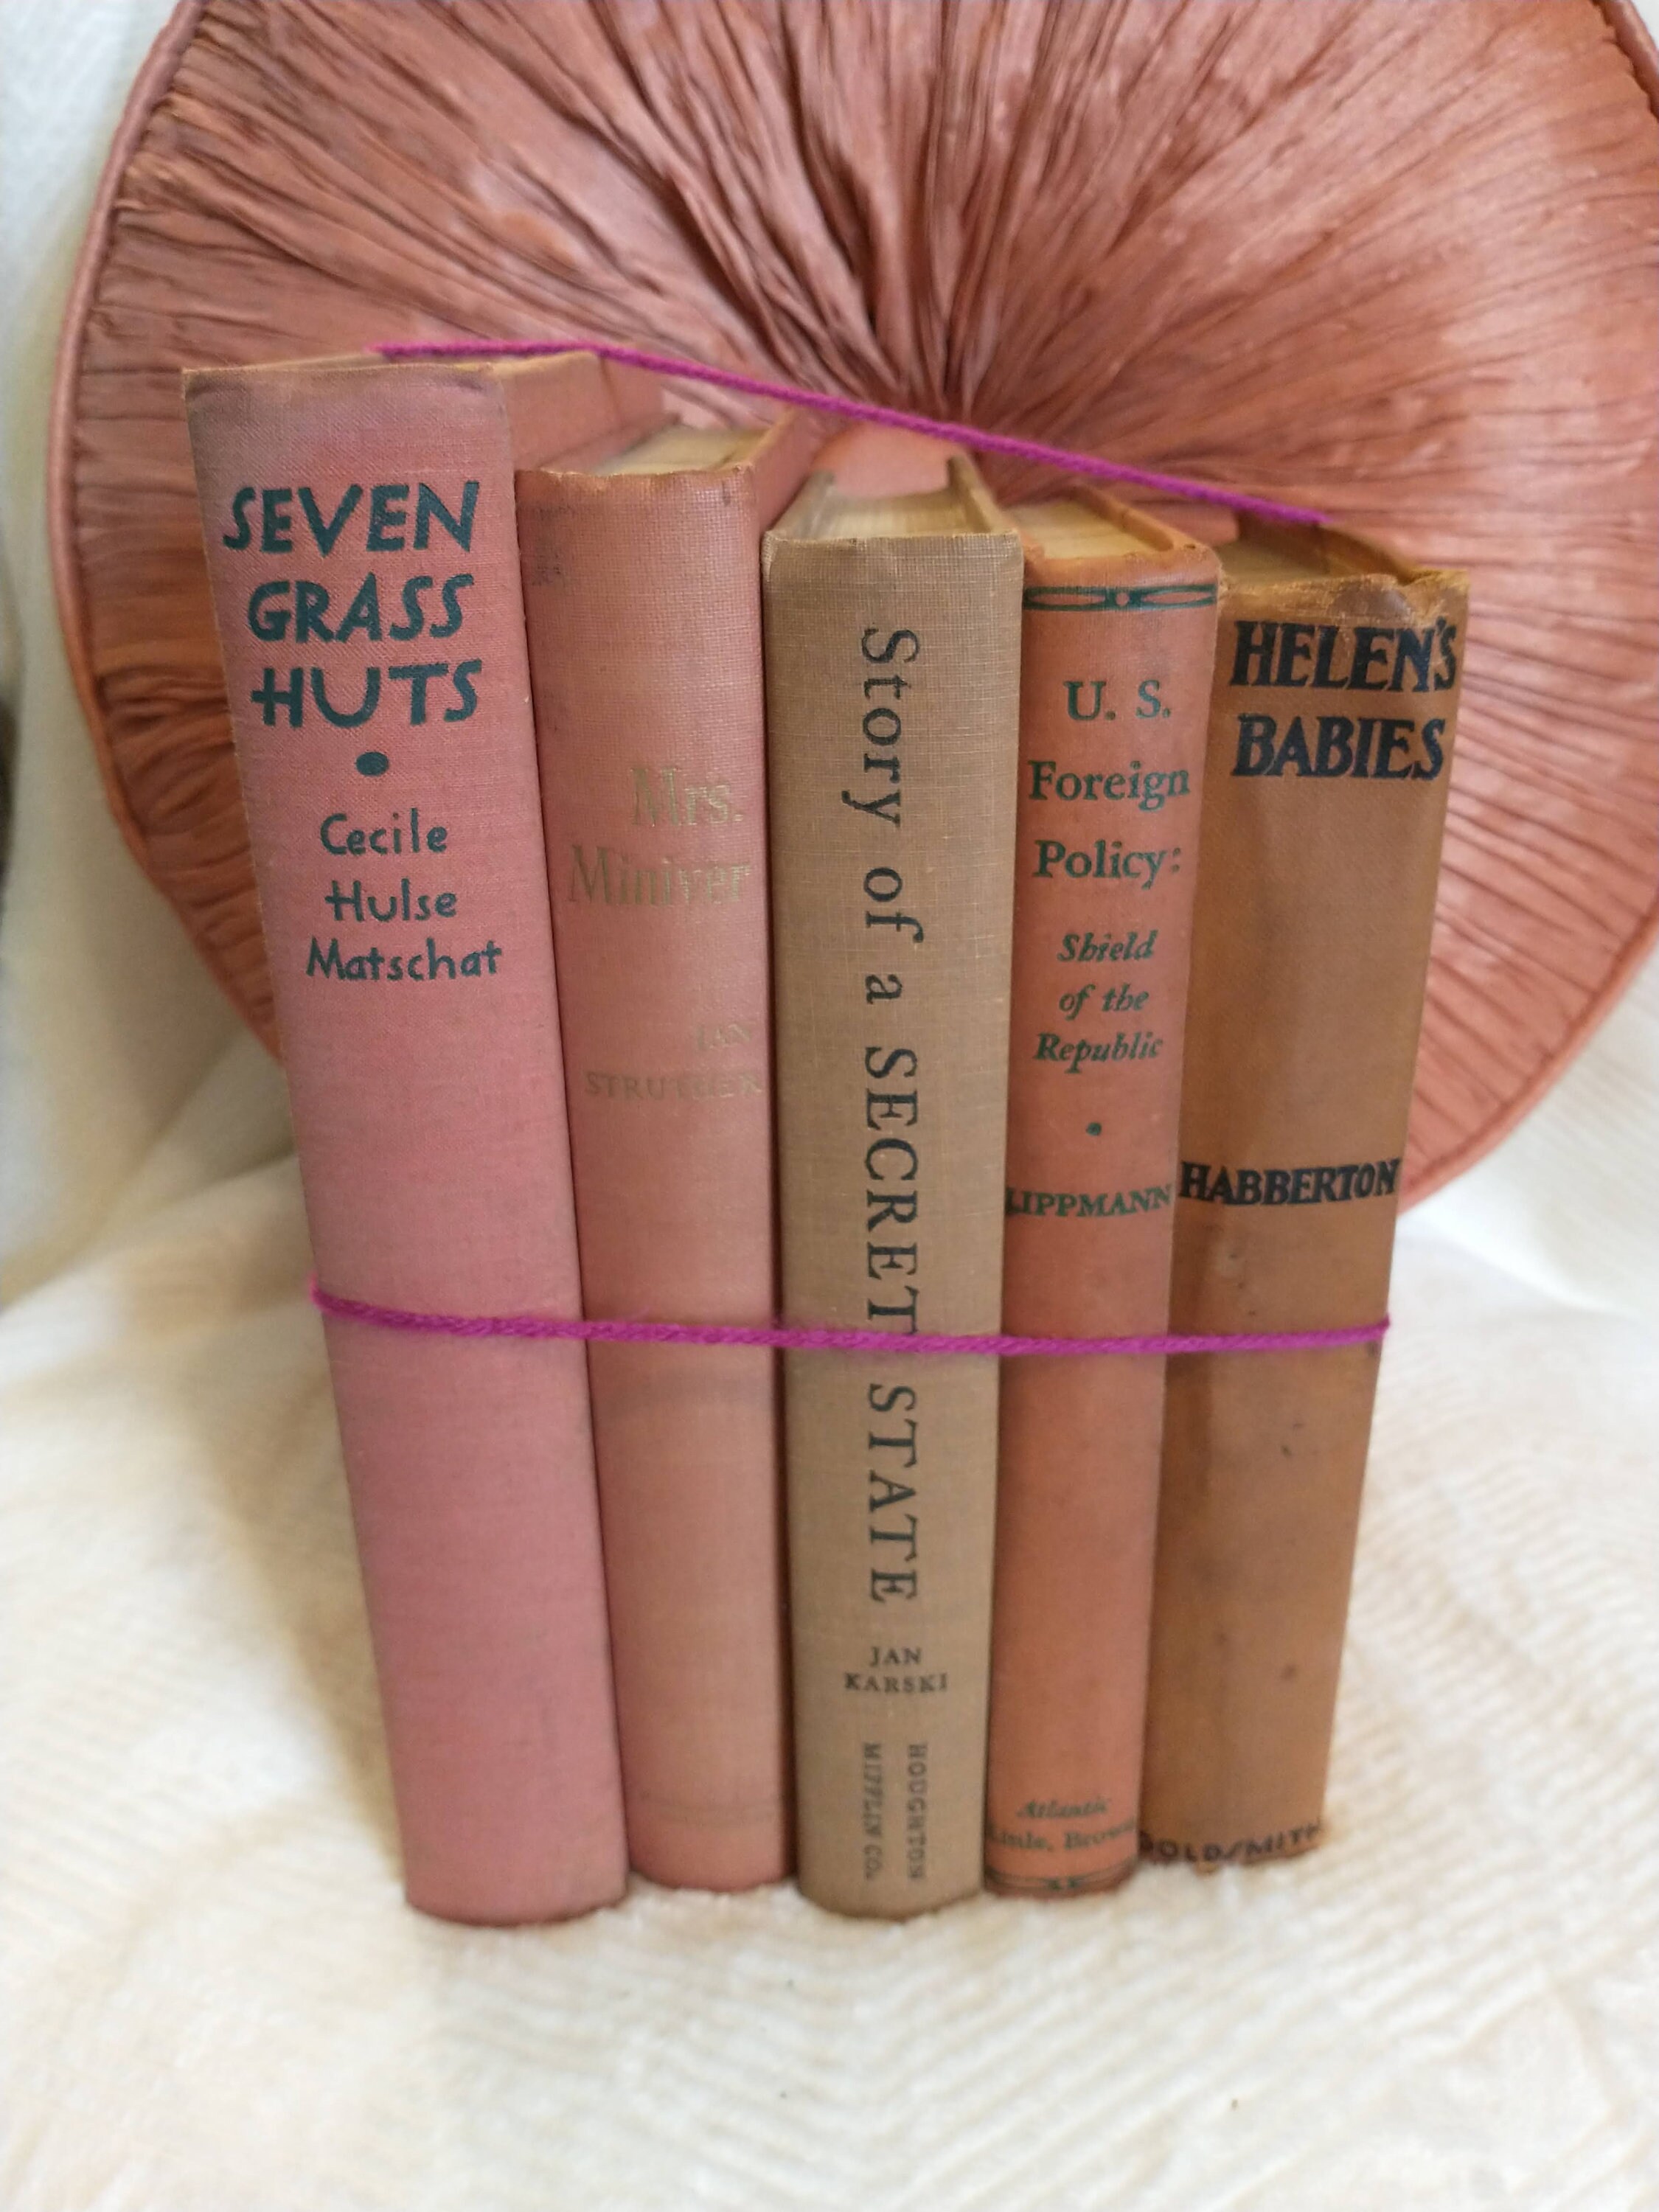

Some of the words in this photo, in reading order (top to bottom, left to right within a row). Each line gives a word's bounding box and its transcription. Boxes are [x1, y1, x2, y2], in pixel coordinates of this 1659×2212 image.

[223, 481, 480, 557] SEVEN
[247, 572, 474, 643] GRASS
[1230, 616, 1456, 692] HELEN'S
[251, 658, 482, 728] HUTS
[1063, 681, 1116, 722] U.
[1135, 680, 1171, 719] S.
[841, 627, 920, 828] Story
[1232, 712, 1445, 780] BABIES
[629, 765, 744, 827] Mrs.
[1029, 760, 1190, 810] Foreign
[320, 808, 448, 855] Cecile
[568, 844, 751, 906] Miniver
[1033, 839, 1180, 889] Policy:
[324, 879, 458, 922] Hulse
[863, 866, 924, 944] of
[305, 936, 502, 981] Matschat
[1057, 930, 1157, 963] Shield
[864, 973, 903, 1005] a
[1059, 984, 1094, 1020] of
[1102, 983, 1150, 1012] the
[1033, 1032, 1163, 1075] Republic
[863, 1045, 919, 1336] SECRET
[1006, 1184, 1172, 1217] LIPPMANN
[1179, 1158, 1401, 1206] HABBERTON
[867, 1382, 919, 1604] STATE
[869, 1646, 922, 1667] JAN
[844, 1672, 948, 1693] KARSKI
[862, 1742, 883, 1837] MIFFLIN
[907, 1741, 928, 1879] HOUGHTON
[862, 1845, 883, 1882] CO.
